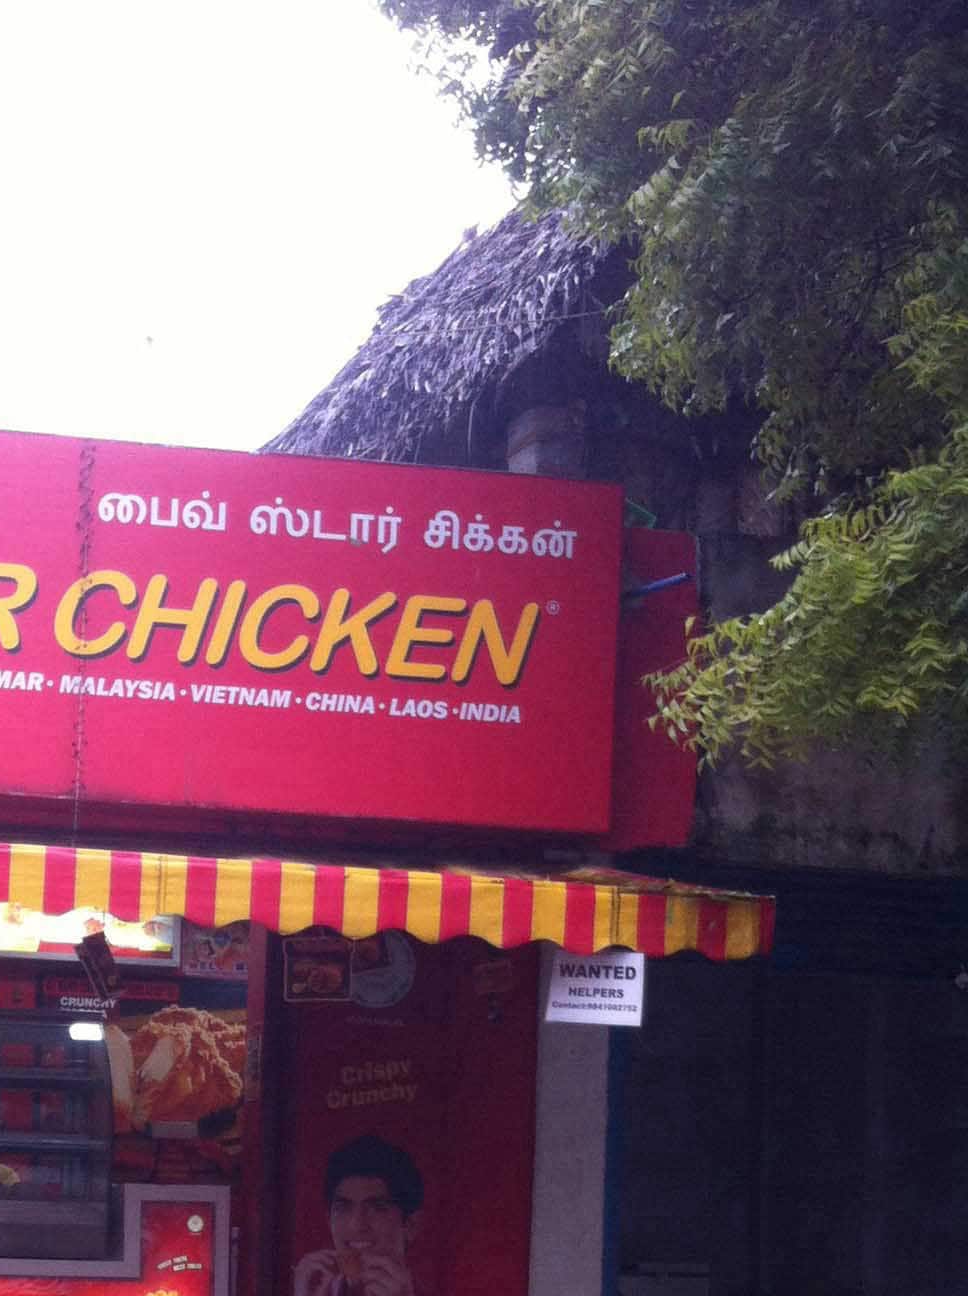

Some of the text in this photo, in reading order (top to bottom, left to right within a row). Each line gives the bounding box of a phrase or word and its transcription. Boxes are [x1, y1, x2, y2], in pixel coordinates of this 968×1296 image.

[96, 490, 579, 560] பைவ் ஸ்டார் சிக்கன்
[52, 568, 543, 689] CHICKEN
[59, 676, 176, 702] MALAYSIA
[190, 683, 292, 709] VIETNAM
[305, 692, 376, 716] CHINA
[389, 698, 449, 720] LAOS
[459, 704, 522, 724] INDIA
[559, 963, 637, 981] WANTED
[568, 986, 625, 999] HELPERS
